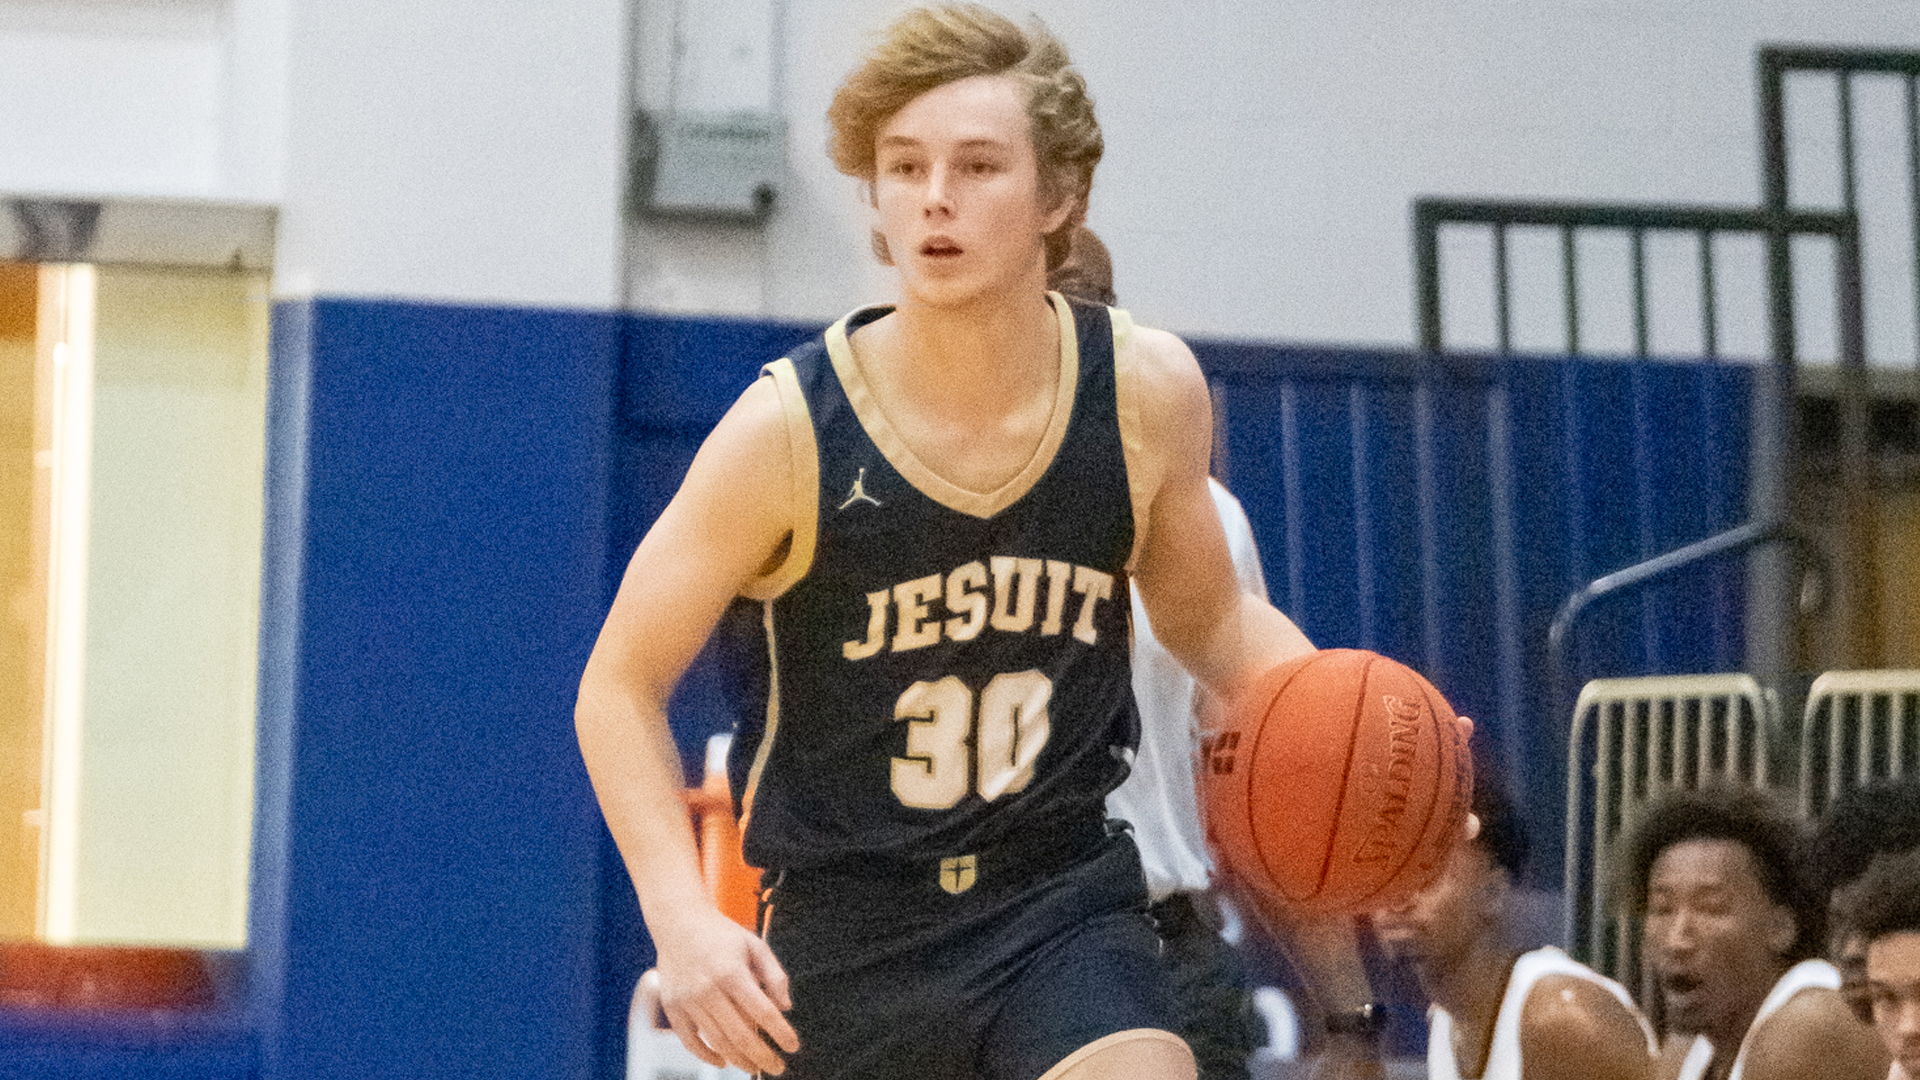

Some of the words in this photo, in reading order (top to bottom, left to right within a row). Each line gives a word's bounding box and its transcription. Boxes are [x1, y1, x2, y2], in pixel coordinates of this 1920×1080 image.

[842, 555, 1114, 661] JESUIT
[890, 669, 1053, 810] 30
[1352, 694, 1422, 868] SPALDING
